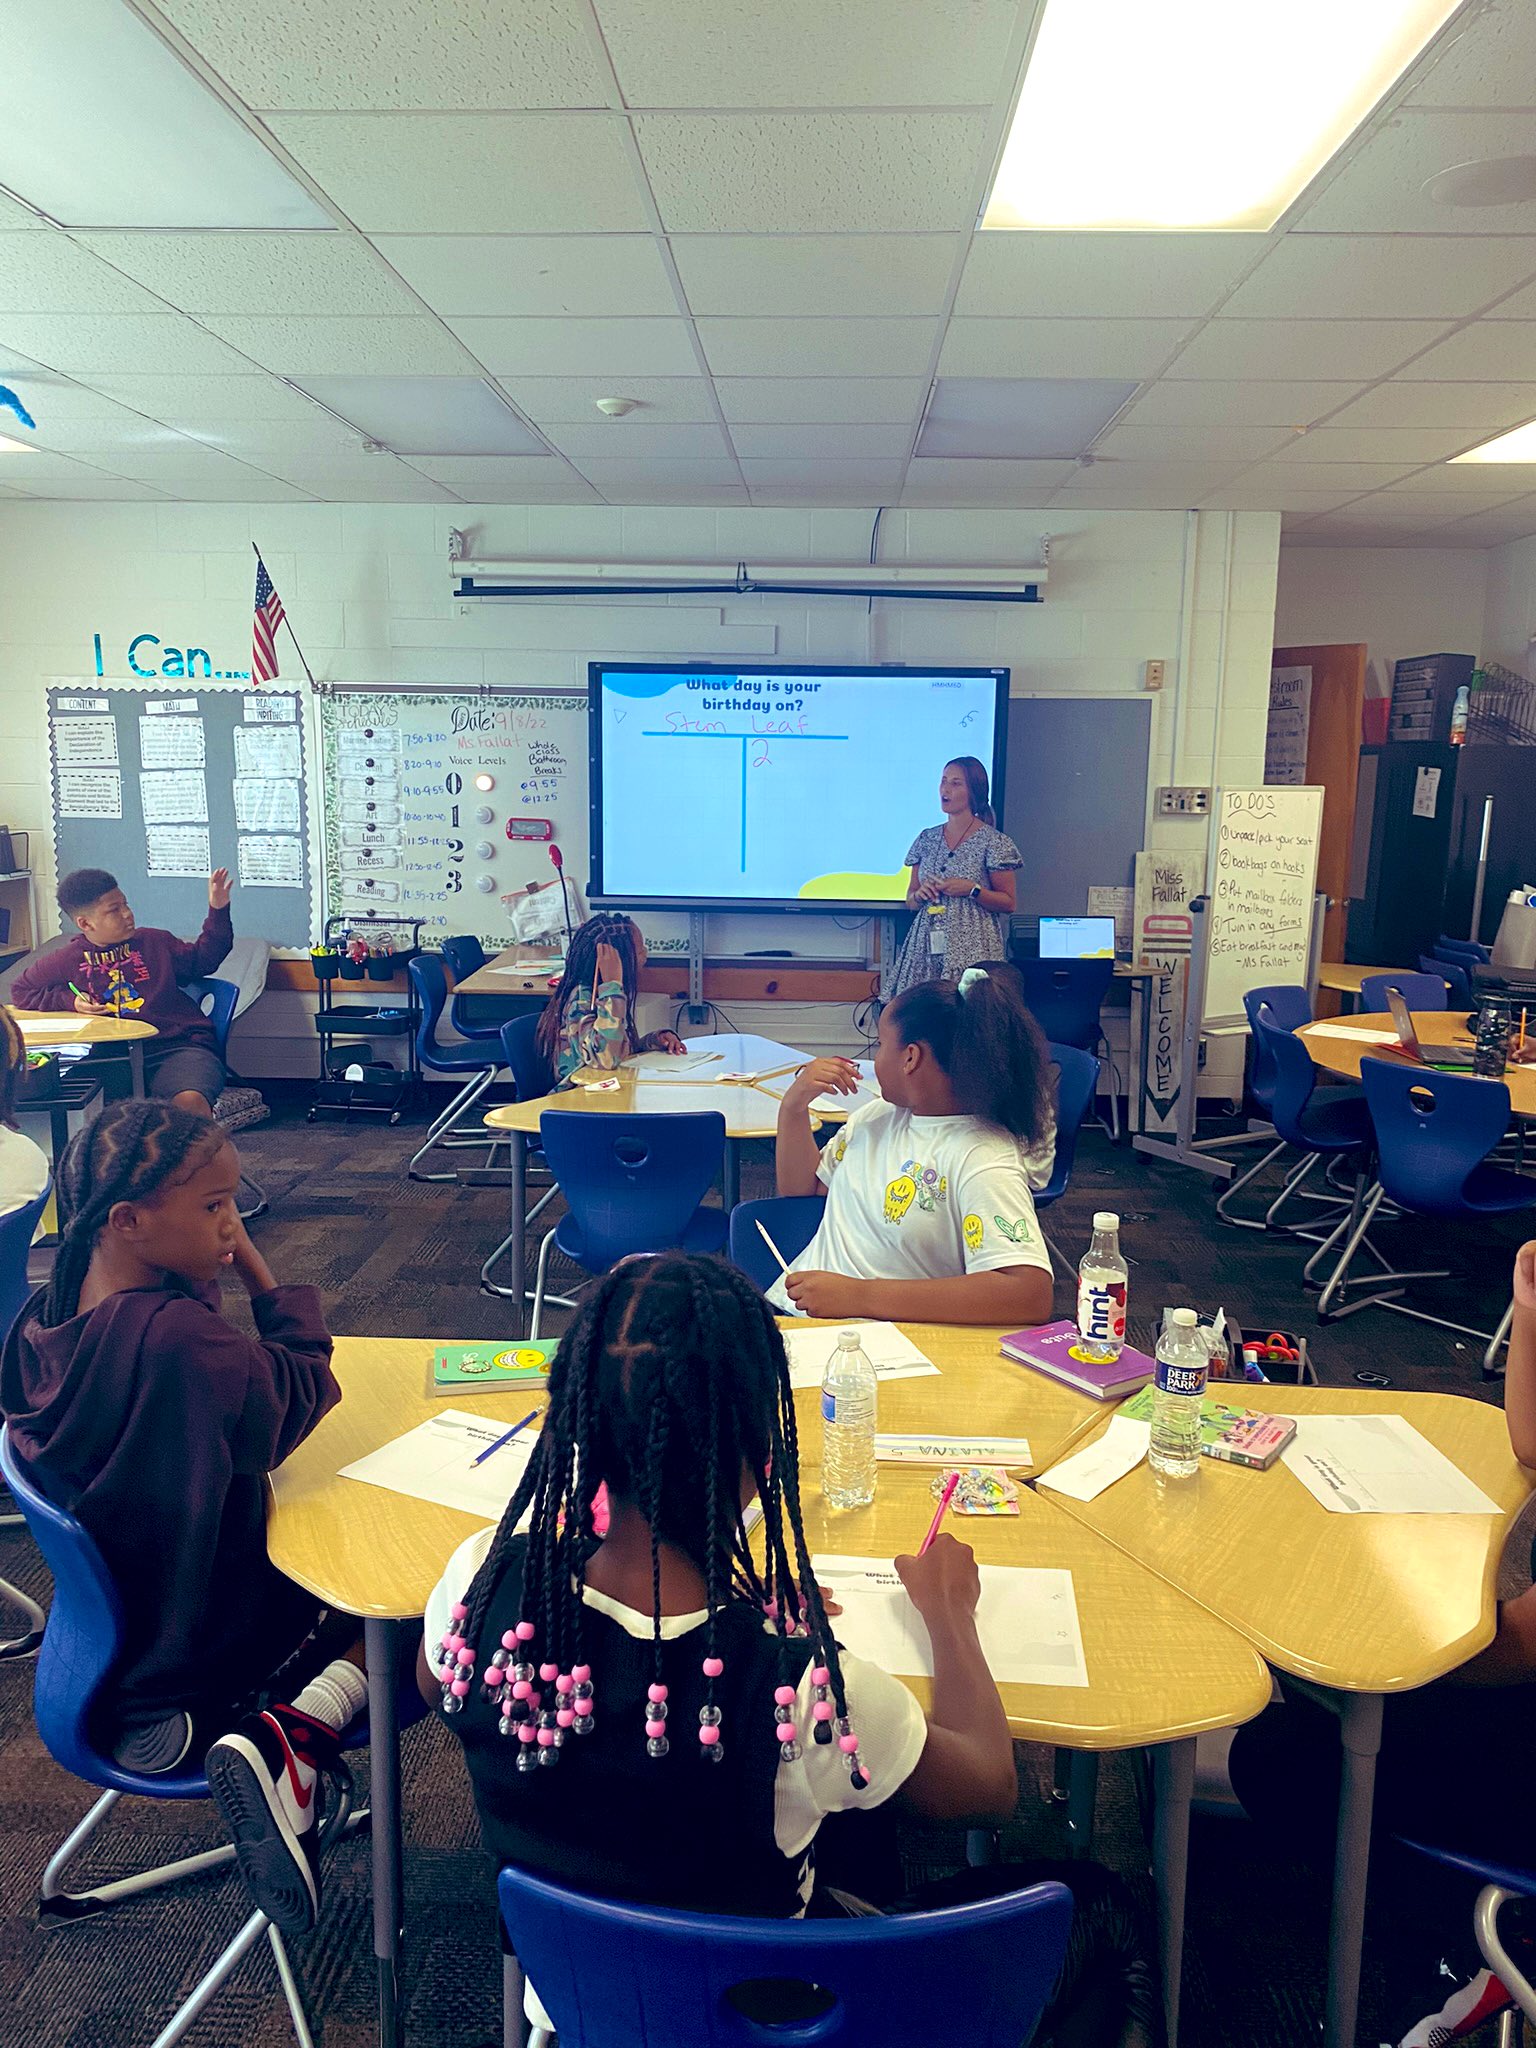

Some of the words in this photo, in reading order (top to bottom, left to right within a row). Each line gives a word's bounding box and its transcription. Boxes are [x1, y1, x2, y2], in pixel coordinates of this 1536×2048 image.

[94, 634, 103, 676] I
[686, 679, 729, 690] What
[733, 679, 762, 694] day
[767, 680, 780, 692] is
[785, 683, 821, 695] your
[69, 700, 96, 709] CONTENT
[162, 701, 181, 711] MATH
[337, 704, 398, 717] TODAY'S
[702, 698, 771, 714] birthday
[775, 700, 804, 711] on?
[257, 710, 283, 721] WRITING
[451, 705, 495, 734] Date:
[495, 710, 547, 731] 9/8/22
[665, 711, 727, 734] Stem
[752, 715, 808, 734] Leaf
[457, 736, 474, 750] Ms
[478, 734, 521, 748] Fallat
[528, 740, 557, 750] Whole
[449, 756, 473, 765] Voice
[478, 756, 507, 765] Levels
[752, 739, 773, 767] 2
[445, 772, 463, 795] 0
[1226, 793, 1242, 809] TO
[451, 804, 460, 828] 1
[362, 833, 385, 843] Lunch
[1275, 835, 1294, 851] your
[1296, 837, 1313, 846] seat
[448, 839, 465, 863] 2
[357, 856, 385, 866] Recess
[1232, 855, 1267, 877] bookbags
[1270, 860, 1280, 869] on
[1283, 859, 1305, 874] hooks
[445, 870, 463, 893] 3
[1155, 869, 1183, 885] Miss
[357, 884, 386, 897] Reading
[1152, 886, 1188, 903] Fallat
[1229, 879, 1242, 896] Put
[1228, 897, 1235, 911] in
[1222, 917, 1245, 934] Turn
[1247, 919, 1256, 931] in
[1259, 921, 1275, 939] any
[1279, 915, 1302, 928] forms
[1221, 939, 1237, 952] Eat
[1239, 940, 1277, 951] breakfast
[1279, 941, 1292, 951] and
[1260, 954, 1291, 968] Fallat
[1156, 958, 1178, 1093] WELCOME
[1087, 1287, 1110, 1340] hint
[1167, 1369, 1196, 1380] DEER
[1167, 1377, 1196, 1390] PARK
